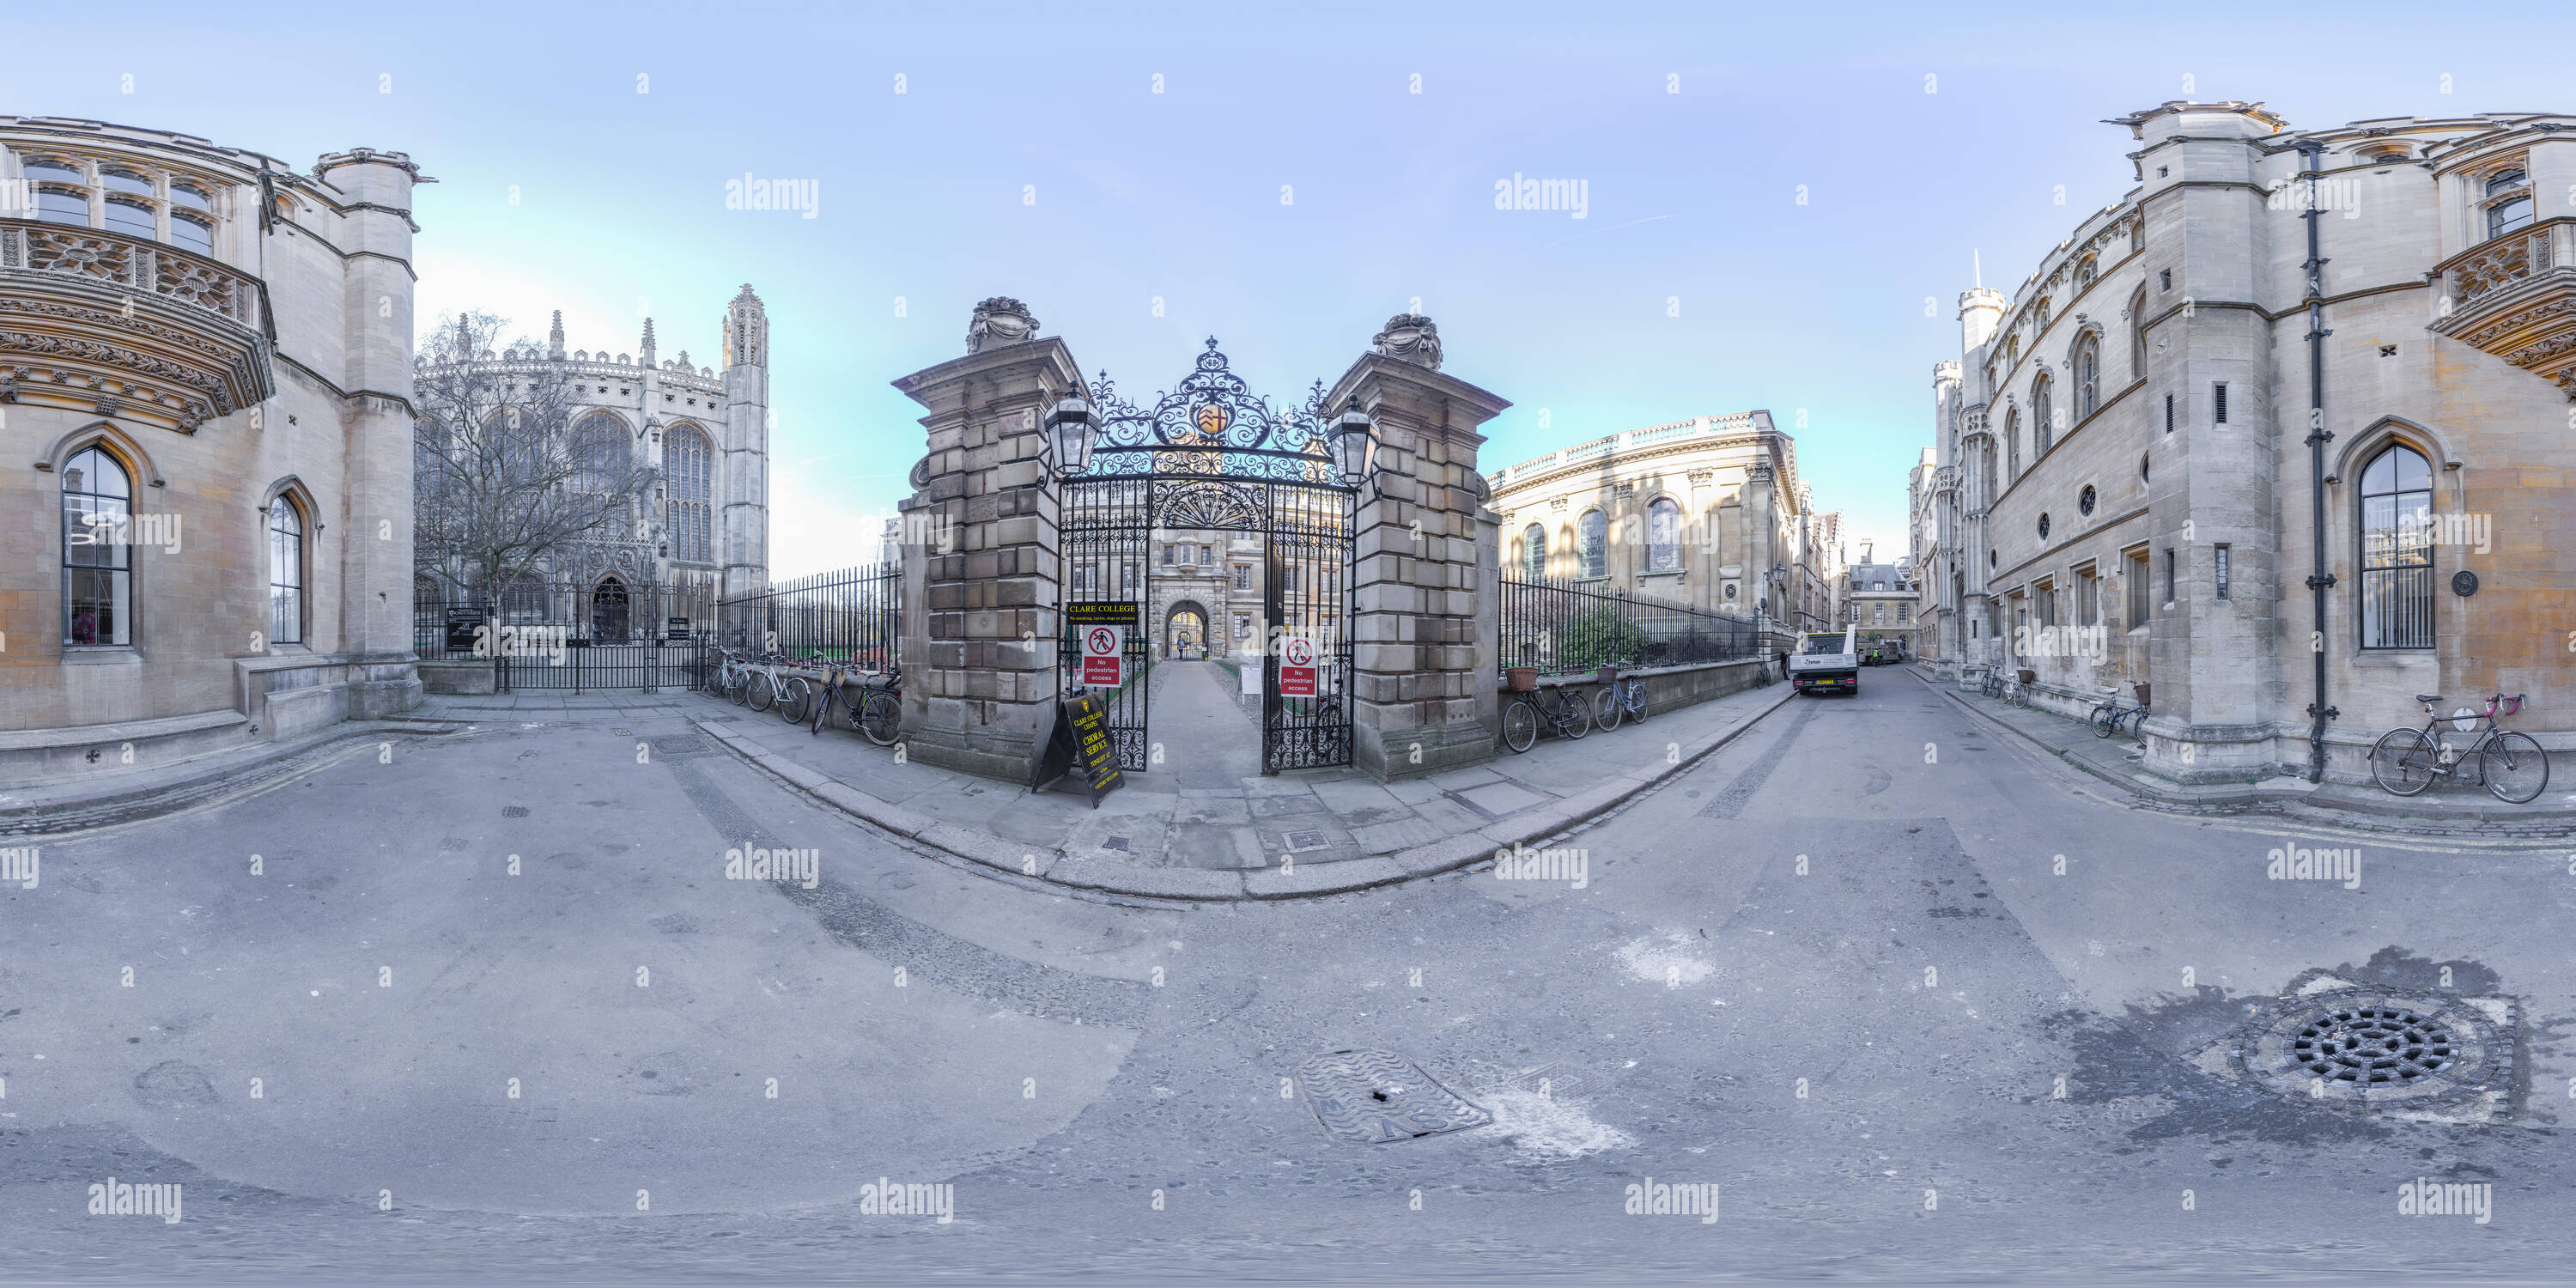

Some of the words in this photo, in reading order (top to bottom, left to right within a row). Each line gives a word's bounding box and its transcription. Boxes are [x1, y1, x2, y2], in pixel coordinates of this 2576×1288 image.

[1074, 717, 1088, 727] CLARE
[1087, 710, 1103, 721] COLLEGE
[1083, 720, 1098, 731] CHAPEL
[1083, 729, 1106, 746] CHORAL
[1085, 738, 1109, 756] SERVICE
[1090, 753, 1106, 768] TONIGHT
